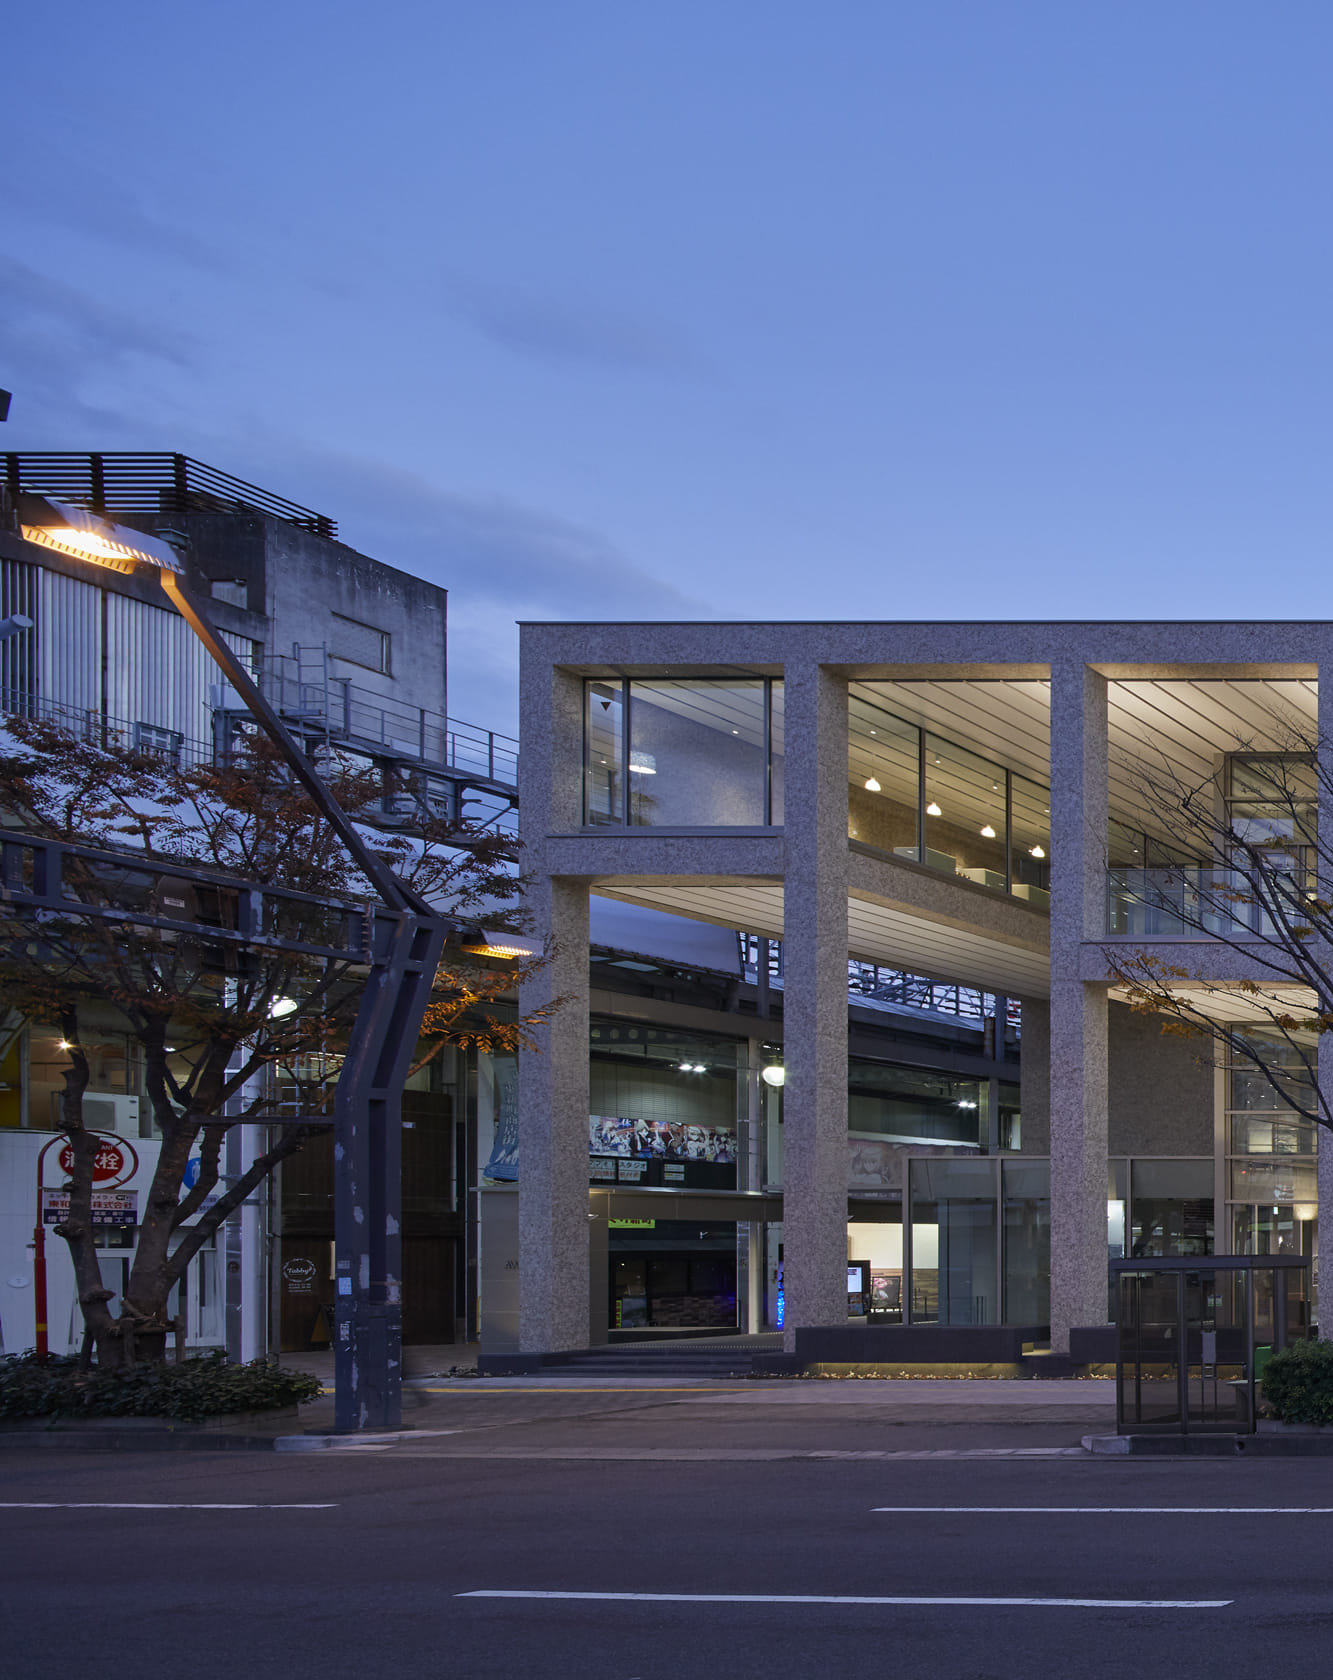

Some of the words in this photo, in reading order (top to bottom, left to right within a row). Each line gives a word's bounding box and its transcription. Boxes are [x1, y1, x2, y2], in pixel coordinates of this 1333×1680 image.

[49, 1200, 133, 1209] 東和株式会社
